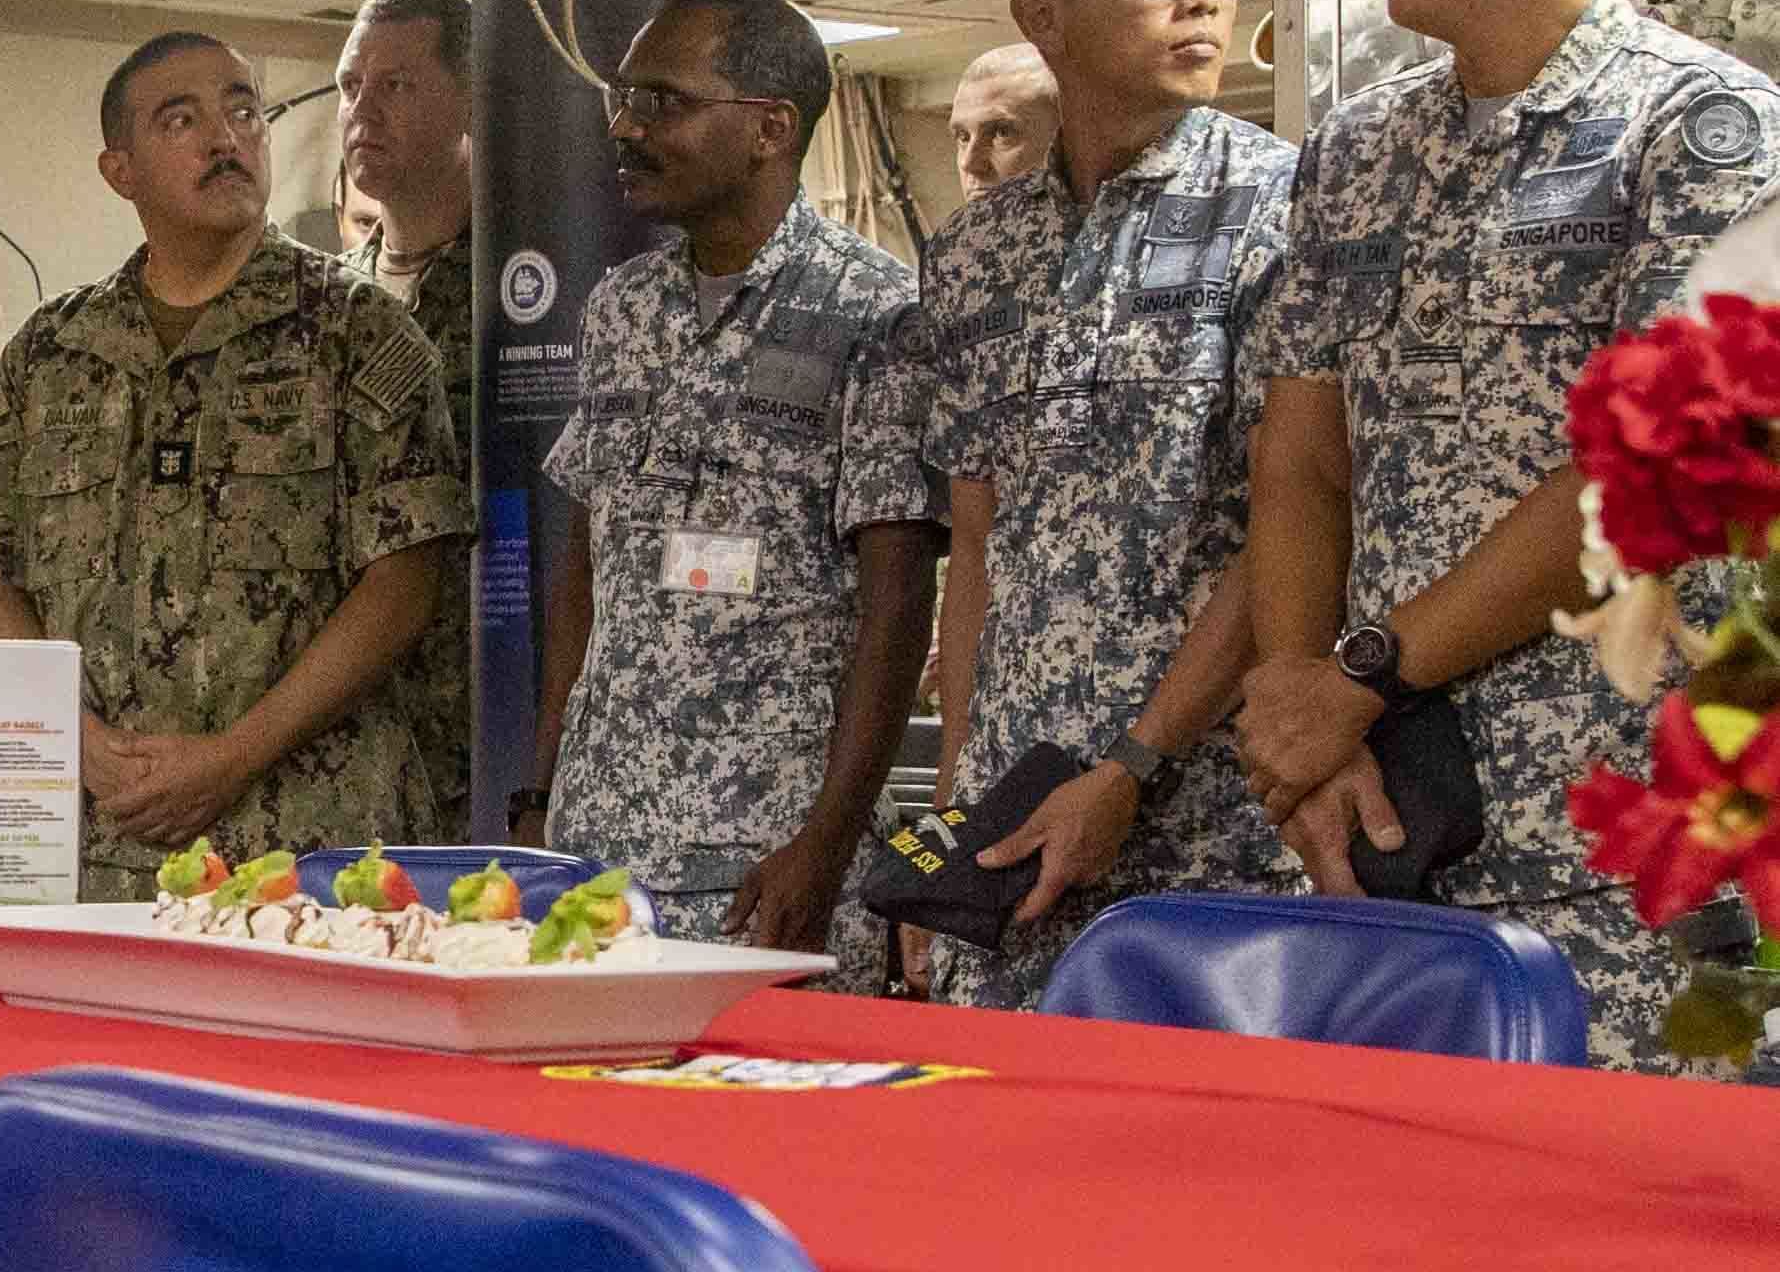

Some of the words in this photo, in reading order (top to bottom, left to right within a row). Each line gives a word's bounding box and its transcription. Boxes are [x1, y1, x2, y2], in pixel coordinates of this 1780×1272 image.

[1499, 221, 1622, 249] SINGAPORE
[1132, 288, 1231, 314] SINGAPORE
[505, 345, 543, 361] WINNING
[545, 344, 573, 359] TEAM
[263, 385, 304, 409] NAVY
[737, 395, 825, 427] SINGAPORE
